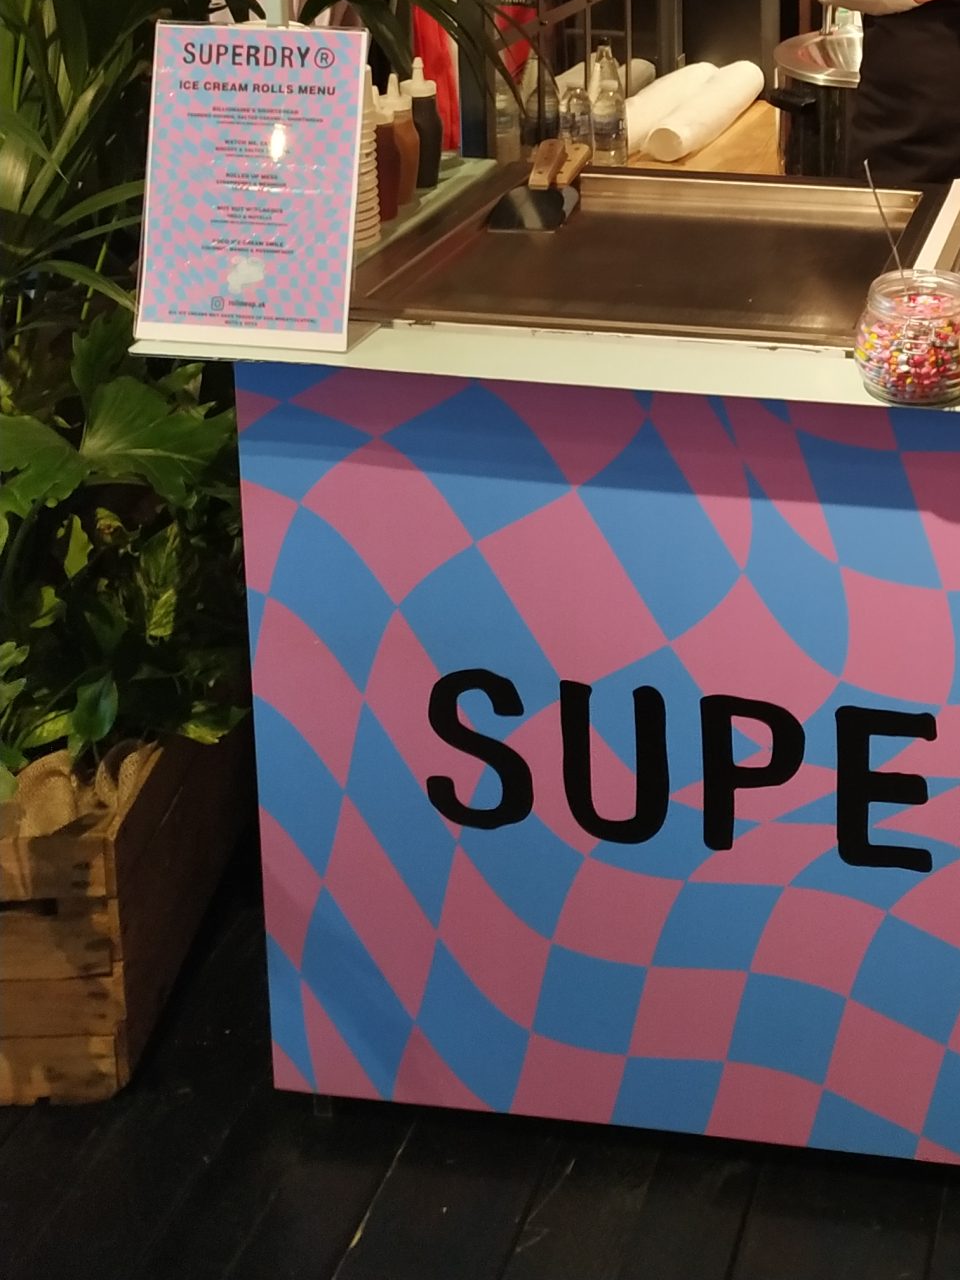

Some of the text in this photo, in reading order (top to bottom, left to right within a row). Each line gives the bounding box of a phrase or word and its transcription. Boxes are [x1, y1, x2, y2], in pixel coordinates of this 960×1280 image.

[179, 80, 336, 96] ICE CREAM ROLLS MENU
